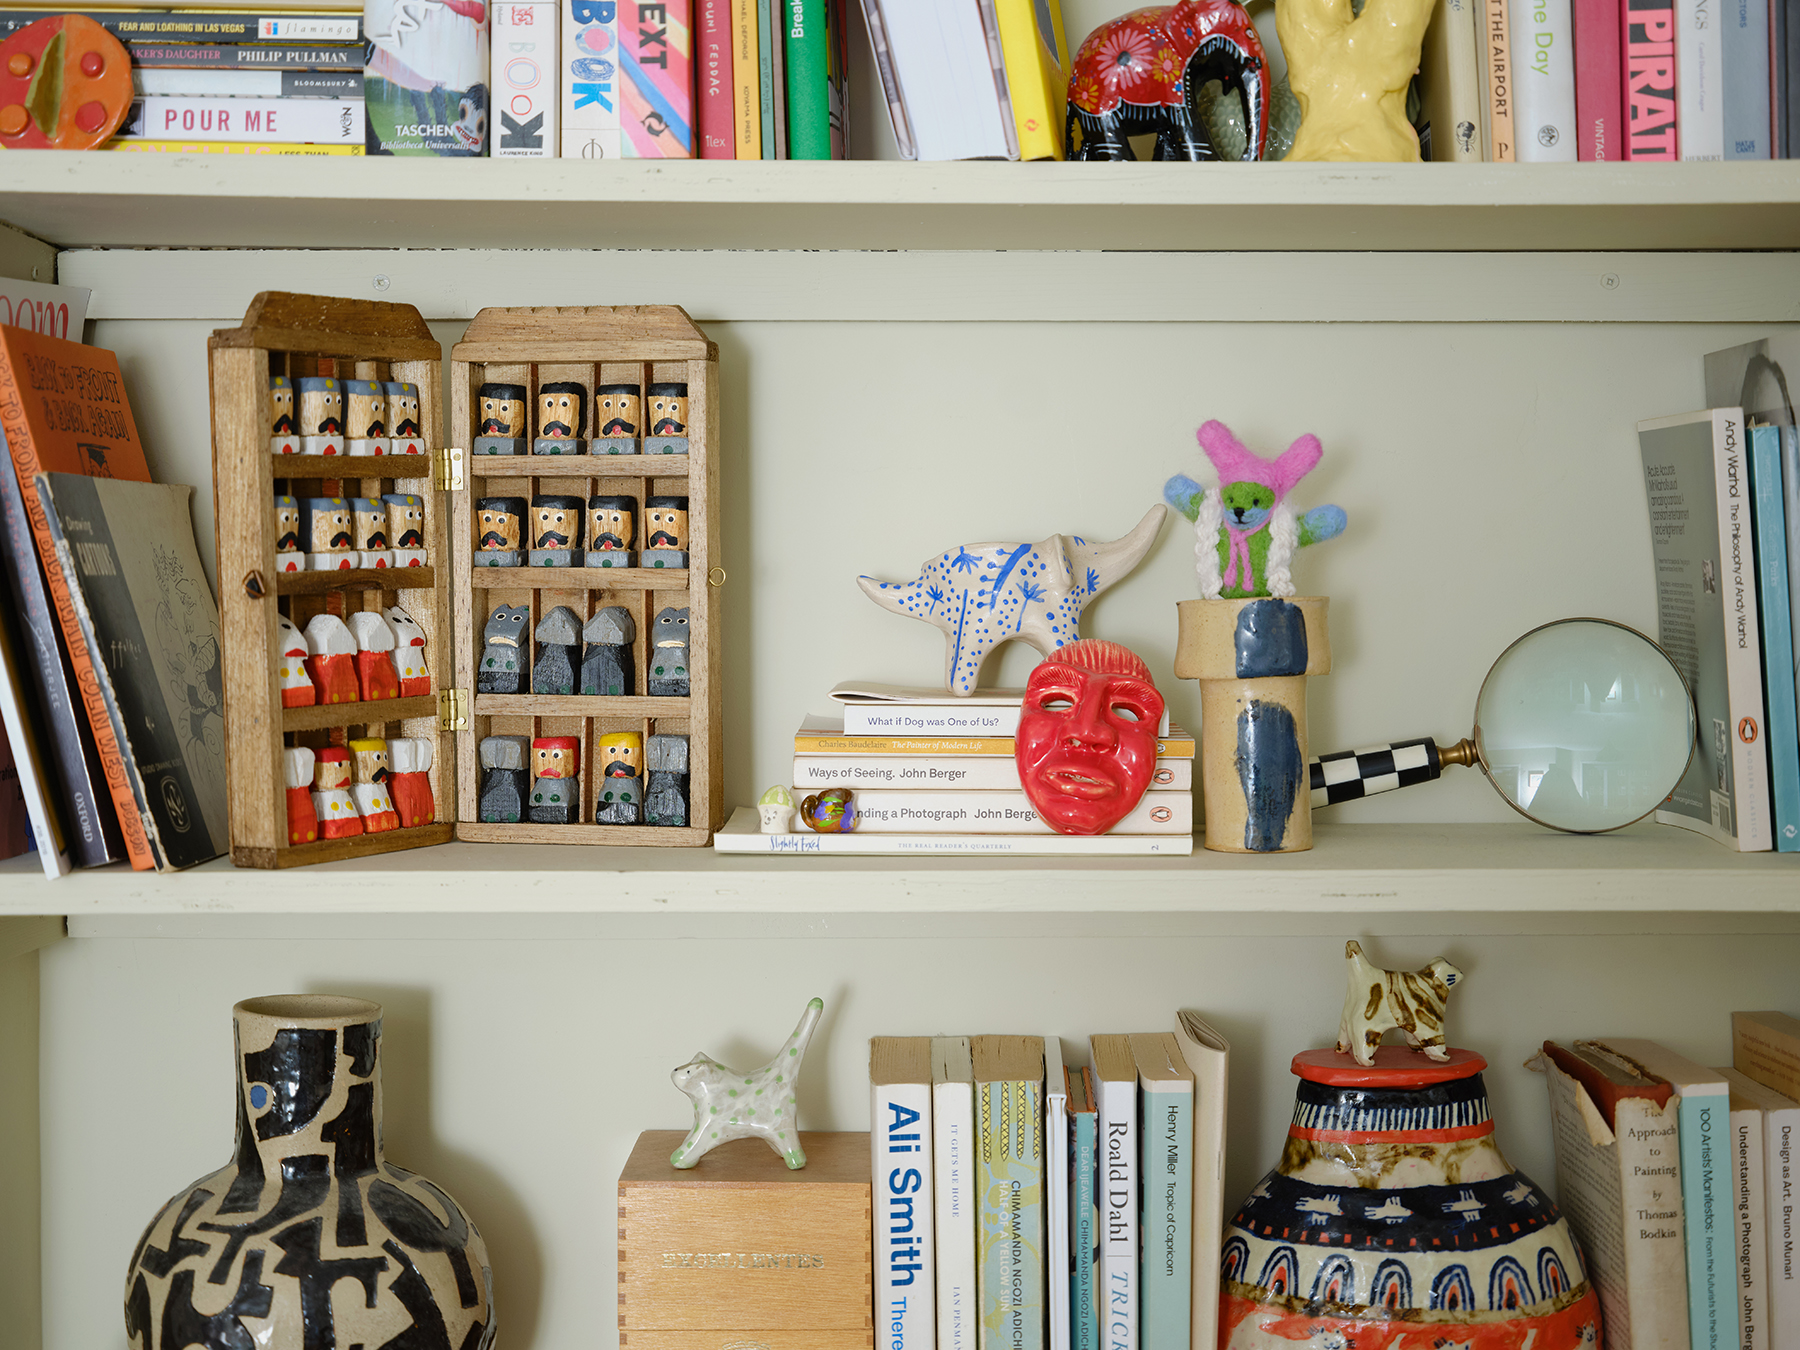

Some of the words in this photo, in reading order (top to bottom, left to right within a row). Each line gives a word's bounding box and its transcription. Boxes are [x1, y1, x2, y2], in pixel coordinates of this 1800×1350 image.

[118, 22, 138, 32] FEAR
[139, 22, 156, 32] AND
[157, 22, 194, 33] LOATHING
[195, 23, 203, 33] IN
[204, 23, 219, 33] LAS
[220, 23, 245, 34] VEGAS
[284, 21, 352, 36] flamingo
[704, 0, 718, 33] OUNI
[1491, 10, 1505, 42] THE
[165, 49, 221, 61] DAUGHTER
[741, 24, 749, 60] DEFORGE
[1530, 33, 1554, 76] Day
[237, 50, 282, 62] PHILIP
[286, 51, 348, 64] PULLMAN
[571, 0, 618, 115] BOOK
[708, 44, 721, 97] FEDDAG
[293, 79, 347, 87] BLOOMSBURY
[1492, 46, 1508, 118] AIRPORT
[743, 86, 751, 117] KOYAMA
[164, 108, 230, 131] POUR
[245, 109, 277, 132] ME
[394, 123, 455, 137] TASCHEN
[379, 139, 424, 151] Bibliotheca
[425, 139, 471, 151] Universalis
[705, 134, 726, 147] ilex
[71, 364, 121, 404] FRONT
[87, 404, 131, 442] AGAIN
[1723, 419, 1737, 454] Andy
[1727, 455, 1741, 499] Warhol
[1730, 503, 1740, 521] The
[1731, 522, 1743, 575] Philosophy
[1734, 575, 1745, 587] of
[1770, 559, 1779, 587] Parks
[38, 534, 63, 598] BACK
[56, 595, 90, 659] AGAIN
[1734, 586, 1746, 614] Andy
[1737, 615, 1748, 649] Warhol
[78, 665, 110, 732] COLIN
[98, 734, 129, 791] WEST
[867, 717, 893, 727] What
[895, 717, 903, 727] if
[904, 717, 924, 731] Dog
[926, 719, 945, 728] was
[947, 717, 968, 728] One
[969, 717, 980, 728] of
[981, 718, 1000, 729] Us?
[818, 740, 847, 751] Charles
[848, 741, 887, 752] Baudelaire
[891, 741, 905, 752] The
[905, 741, 932, 752] Painter
[932, 742, 941, 754] of
[941, 743, 968, 753] Modern
[970, 742, 983, 754] Life
[808, 766, 839, 780] Ways
[840, 766, 852, 778] of
[854, 767, 896, 780] Seeing.
[899, 767, 927, 779] John
[929, 767, 967, 781] Berger
[74, 791, 93, 843] OXFORD
[891, 810, 898, 819] a
[900, 808, 967, 822] Photograph
[974, 808, 1002, 820] John
[1750, 793, 1758, 838] CLASSICS
[769, 835, 799, 852] Slightly
[800, 835, 821, 852] Foxed
[970, 843, 1012, 851] QUARTERLY
[887, 1101, 921, 1154] Ali
[950, 1124, 959, 1137] IT
[1165, 1105, 1179, 1142] Henry
[1627, 1125, 1677, 1141] Approach
[1700, 1107, 1711, 1133] 100
[950, 1139, 960, 1167] GETS
[1108, 1120, 1128, 1183] Roald
[1649, 1148, 1661, 1157] to
[1701, 1134, 1713, 1169] Artists'
[1779, 1125, 1792, 1163] Design
[1080, 1146, 1089, 1173] DEAR
[1165, 1145, 1178, 1175] Miller
[1633, 1166, 1678, 1179] Painting
[1738, 1125, 1750, 1212] Understanding
[1782, 1165, 1791, 1179] as
[951, 1169, 960, 1185] ME
[951, 1187, 960, 1218] HOME
[998, 1180, 1009, 1208] HALF
[1080, 1174, 1089, 1219] IJEAWELE
[1164, 1181, 1177, 1211] Tropic
[1652, 1190, 1663, 1202] by
[1702, 1170, 1714, 1234] Manifestos:
[1782, 1181, 1792, 1202] Art.
[887, 1166, 923, 1287] Smith
[999, 1210, 1009, 1227] OF
[1011, 1180, 1022, 1266] CHIMAMANDA
[1108, 1189, 1129, 1244] Dahl
[1166, 1213, 1176, 1222] of
[1636, 1208, 1678, 1221] Thomas
[1782, 1205, 1793, 1239] Bruno
[1000, 1230, 1009, 1239] A
[1639, 1228, 1677, 1240] Bodkin
[1705, 1237, 1714, 1258] From
[661, 1252, 824, 1269] EXCELLENTES
[1000, 1242, 1010, 1286] YELLOW
[1080, 1220, 1089, 1287] CHIMAMANDA
[1164, 1223, 1177, 1277] Capricorn
[1740, 1221, 1753, 1289] Photograph
[1783, 1241, 1795, 1281] Munari
[1706, 1259, 1714, 1271] the
[952, 1286, 961, 1306] IAN
[1000, 1288, 1010, 1312] SUN
[1012, 1269, 1023, 1307] NGOZI
[1706, 1273, 1716, 1309] Futurists
[1080, 1288, 1089, 1319] NGOZI
[1708, 1309, 1716, 1318] to
[1743, 1295, 1753, 1323] John
[1709, 1319, 1717, 1332] the
